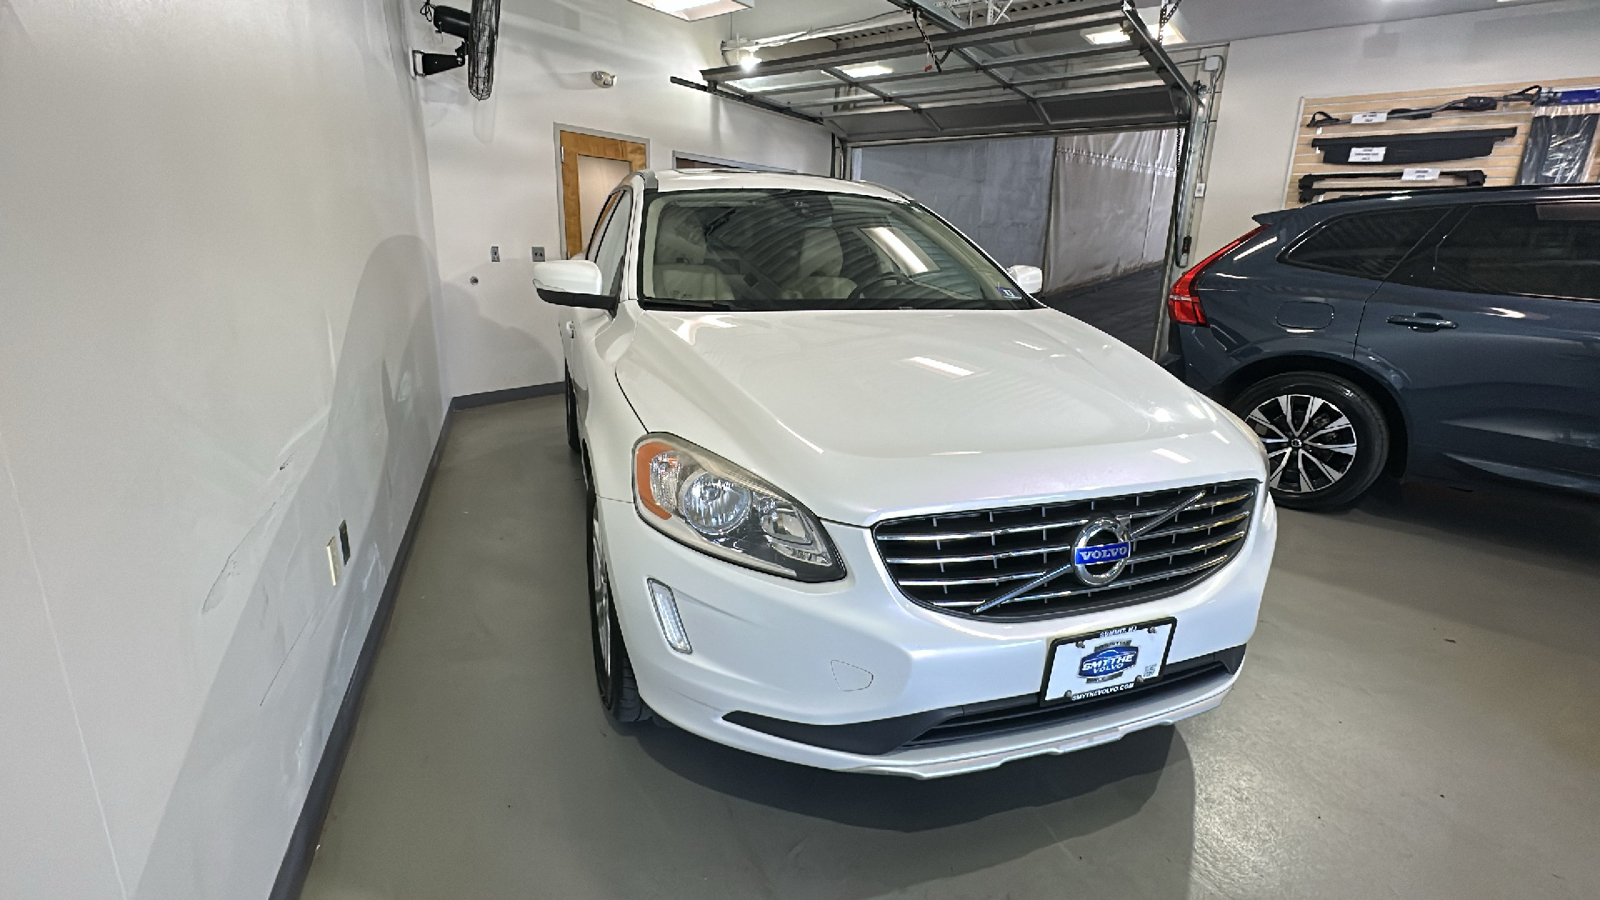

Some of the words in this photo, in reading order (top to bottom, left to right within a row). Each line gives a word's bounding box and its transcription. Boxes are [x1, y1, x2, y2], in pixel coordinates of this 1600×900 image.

[1080, 546, 1127, 561] VOLVO
[1082, 654, 1134, 671] SMYTHE
[1093, 663, 1124, 674] VOLVO
[1071, 683, 1134, 701] SMYTHEVOLVO.COM
